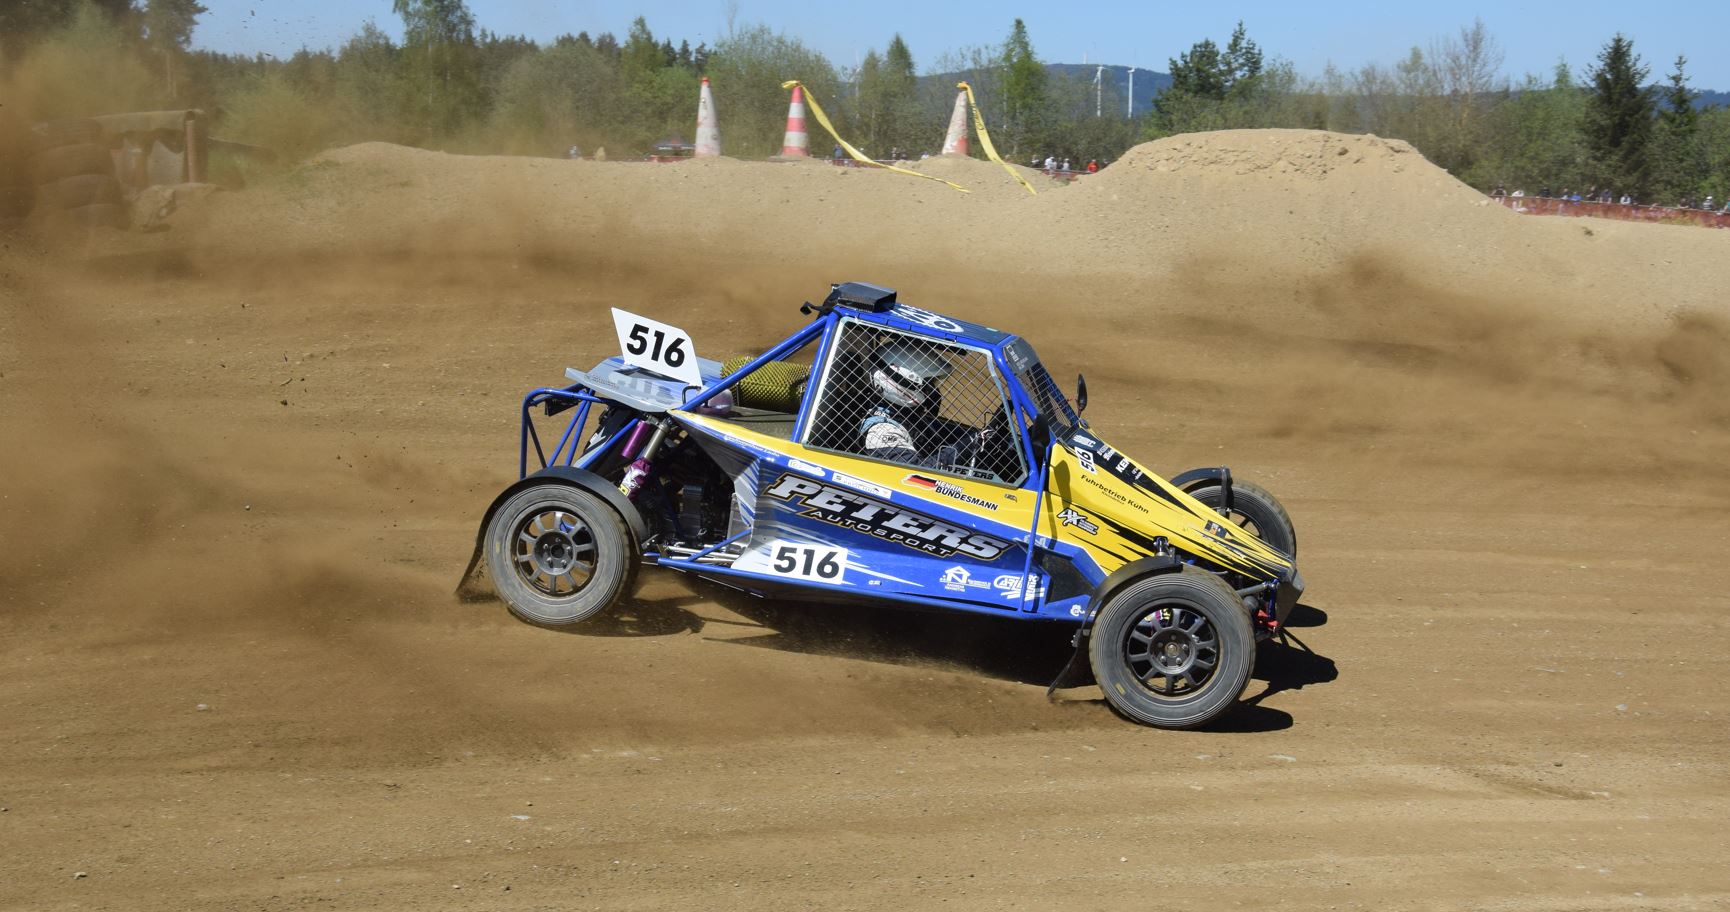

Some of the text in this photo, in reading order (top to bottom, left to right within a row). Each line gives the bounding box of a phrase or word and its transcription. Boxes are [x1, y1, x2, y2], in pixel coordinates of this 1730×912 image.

[627, 323, 686, 368] 516
[1077, 450, 1095, 472] 516
[935, 480, 963, 493] HENRIK
[935, 486, 999, 511] BUNDESMANN
[1081, 474, 1127, 502] Fuhrbetrieb
[1127, 499, 1149, 514] Kuhn
[766, 475, 1010, 558] PETERS
[810, 511, 951, 555] AUTOSPORT
[773, 546, 840, 579] 516
